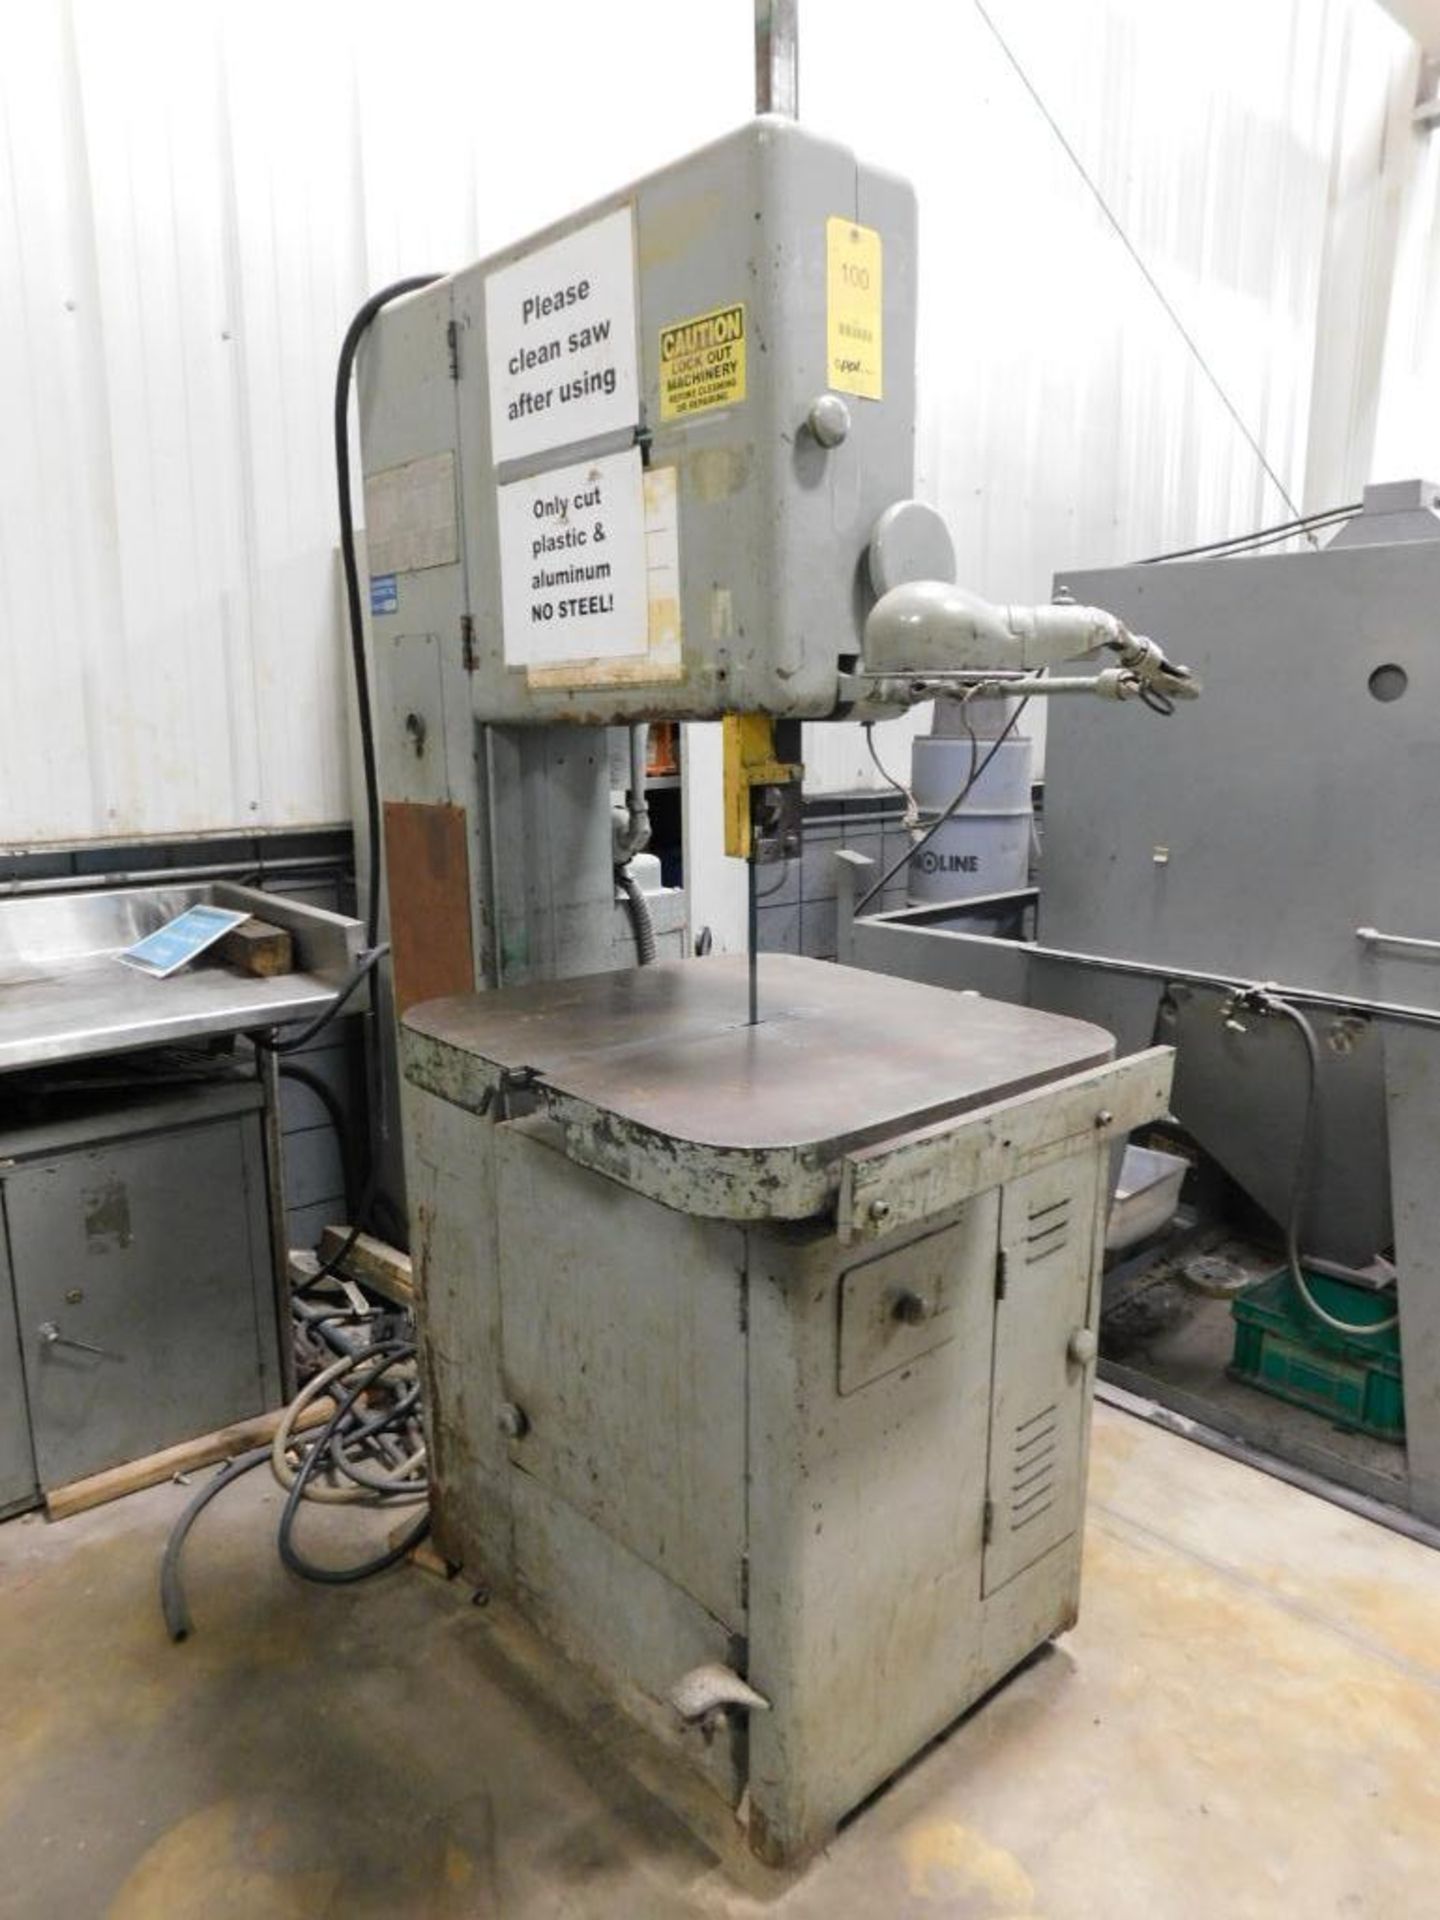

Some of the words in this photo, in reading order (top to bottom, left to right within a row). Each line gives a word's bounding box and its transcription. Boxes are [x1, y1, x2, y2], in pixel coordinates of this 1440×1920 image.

[523, 279, 590, 325] Please
[508, 339, 561, 376] clean
[568, 319, 611, 353] saw
[663, 311, 741, 360] CAUTION
[667, 361, 737, 392] MACHINERY
[671, 357, 703, 375] LOCK
[707, 345, 732, 364] OUT
[508, 392, 553, 421] after
[560, 367, 616, 404] using
[533, 494, 569, 519] Only
[574, 487, 602, 510] cut
[532, 528, 587, 560] plastic
[593, 521, 606, 543] &
[531, 562, 611, 590] aluminum
[531, 603, 553, 623] NO
[558, 594, 614, 619] STEEL!
